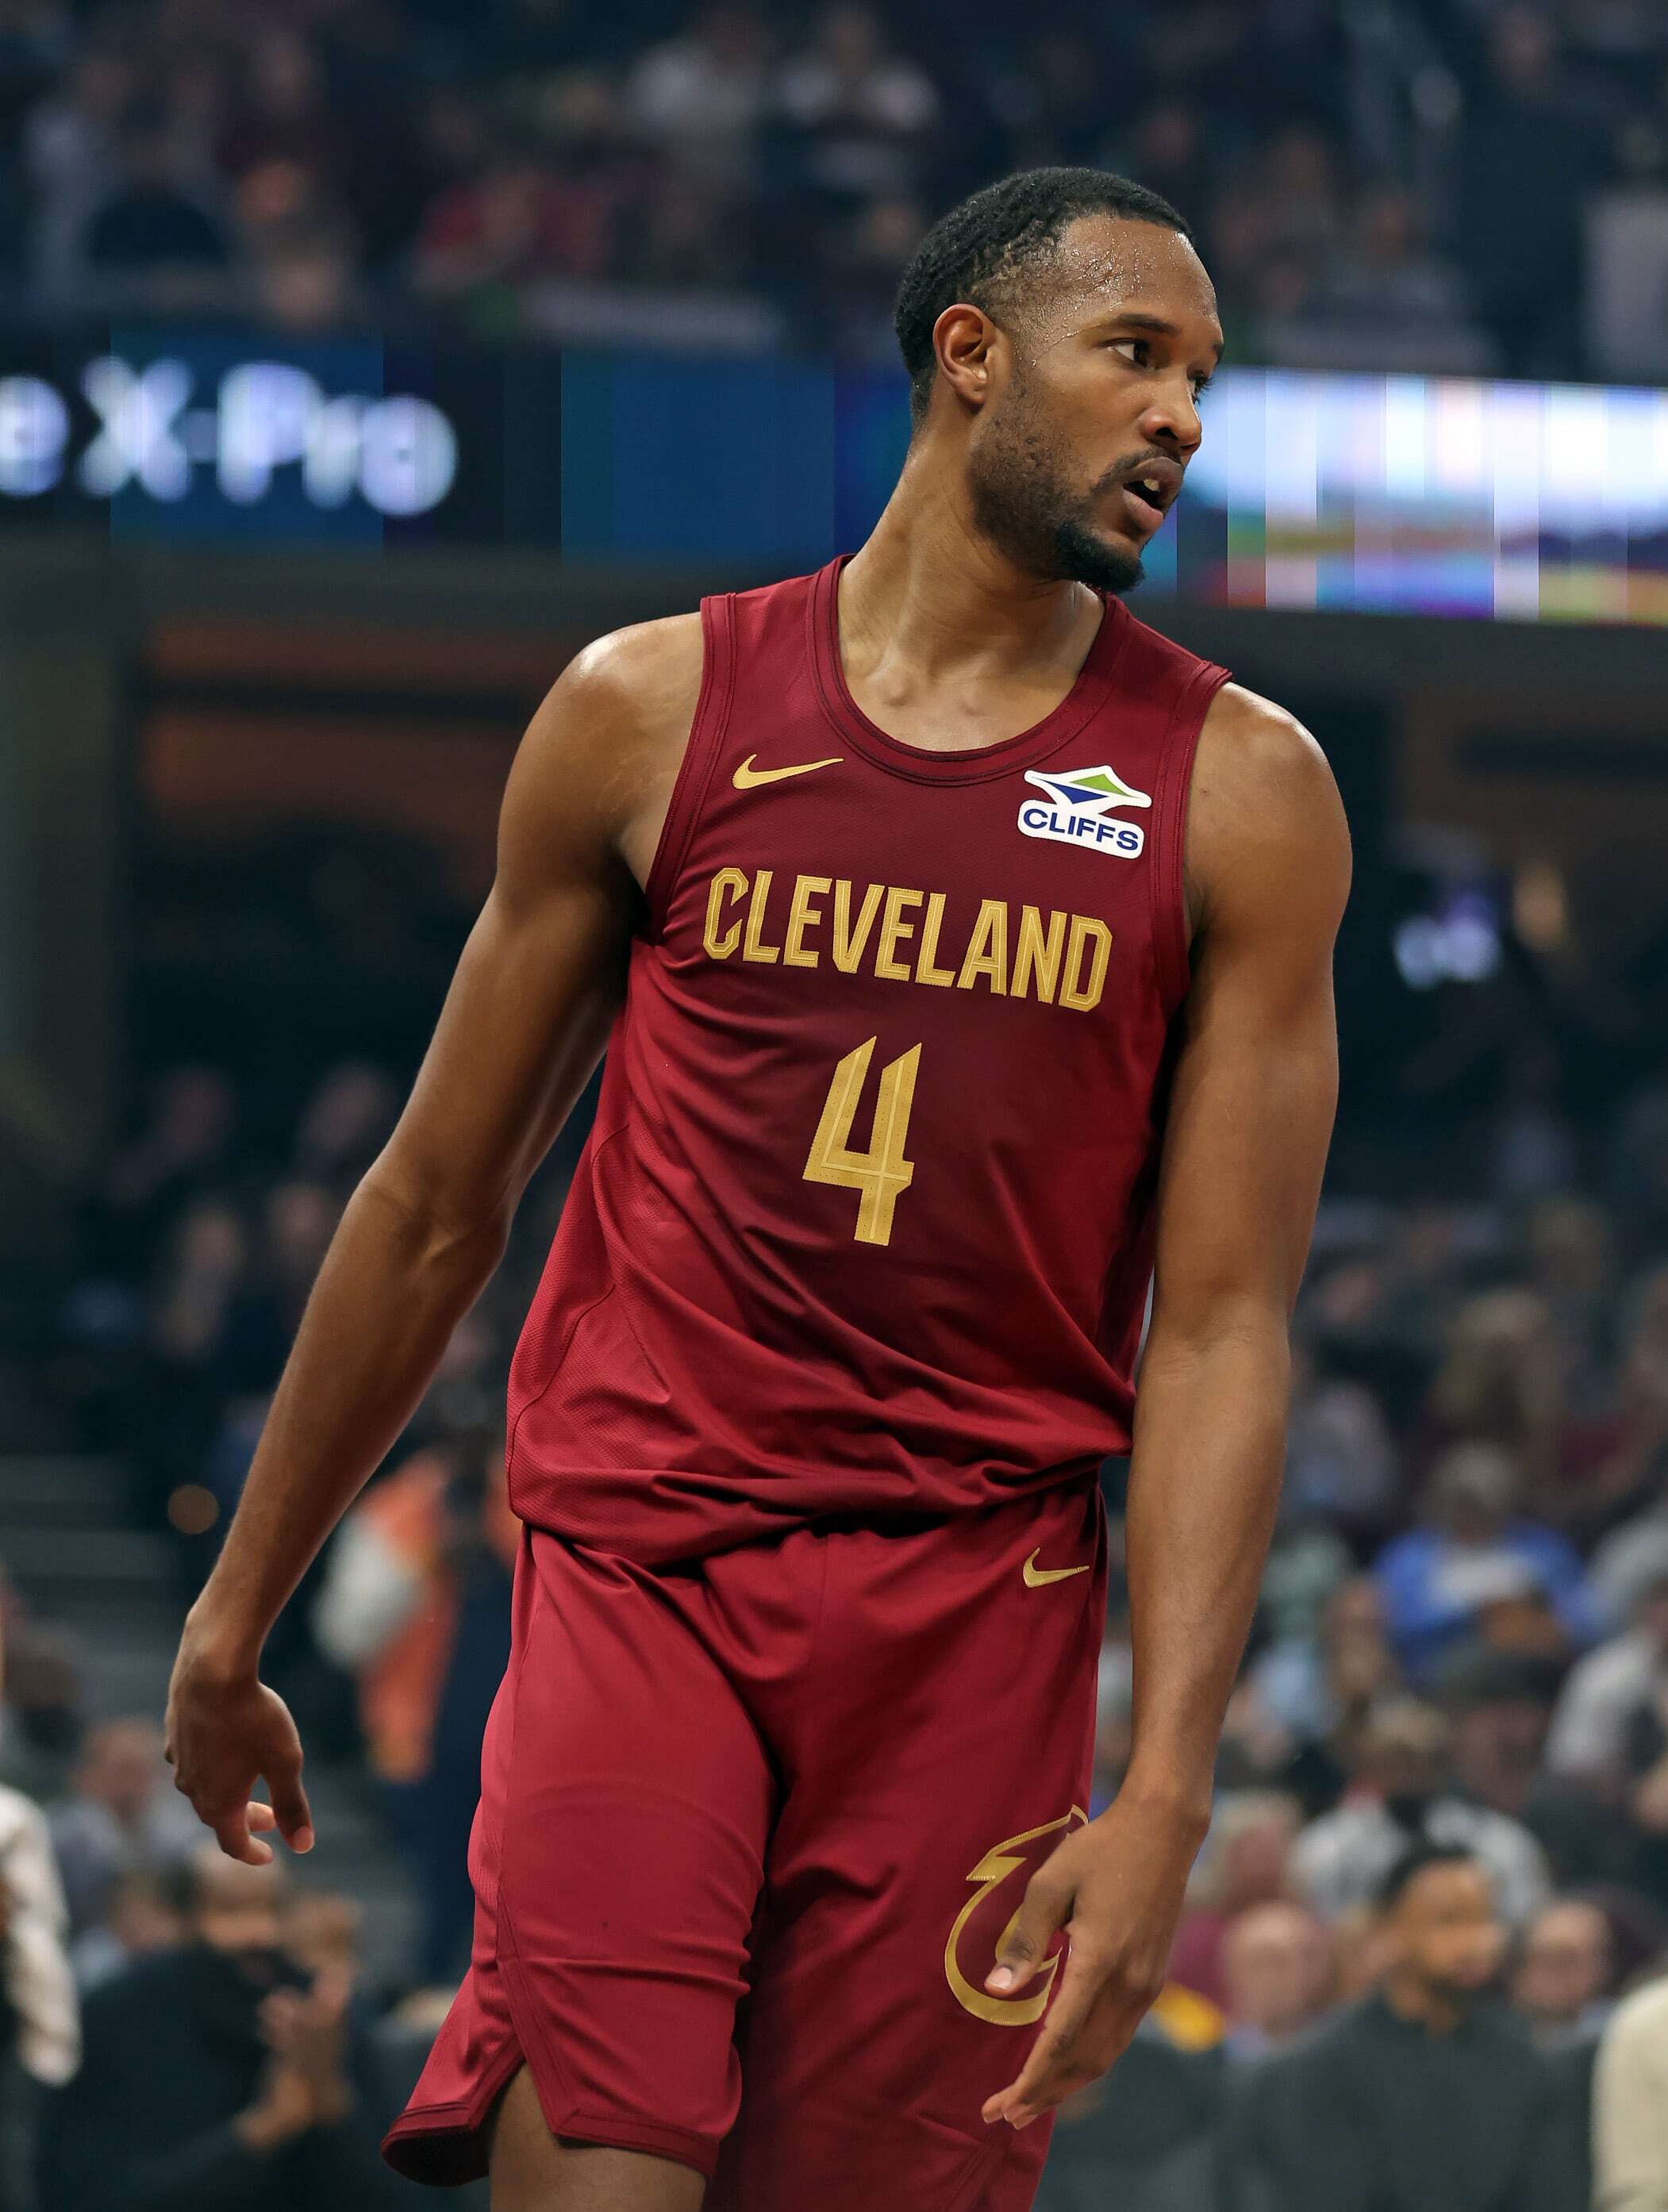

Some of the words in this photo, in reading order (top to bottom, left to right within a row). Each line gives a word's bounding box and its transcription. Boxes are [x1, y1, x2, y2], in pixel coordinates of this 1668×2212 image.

[1024, 808, 1138, 851] CLIFFS
[703, 867, 1113, 1012] CLEVELAND
[803, 1035, 922, 1246] 4
